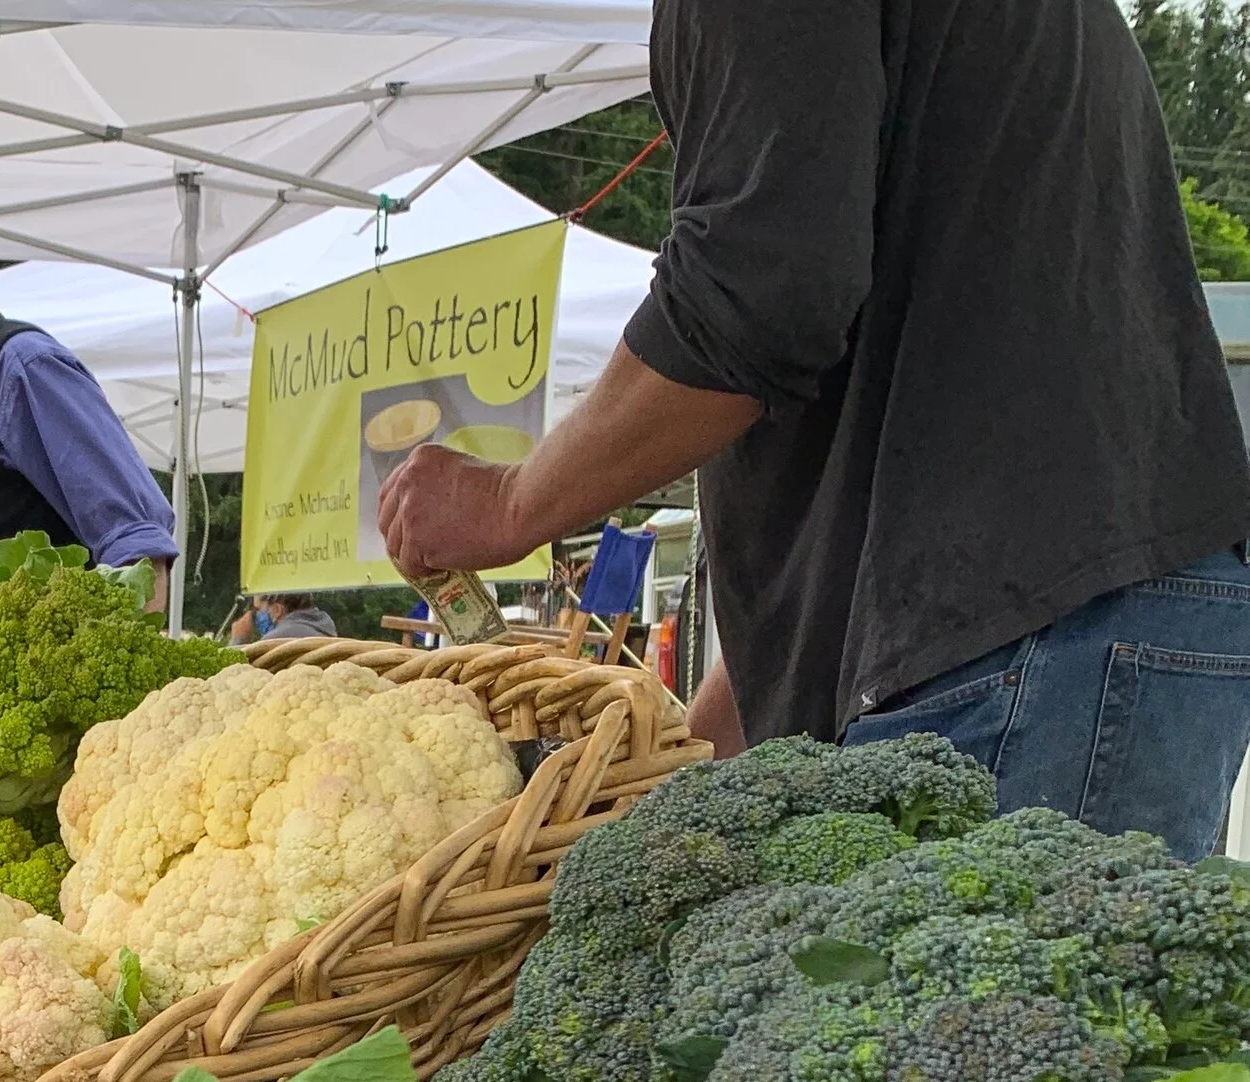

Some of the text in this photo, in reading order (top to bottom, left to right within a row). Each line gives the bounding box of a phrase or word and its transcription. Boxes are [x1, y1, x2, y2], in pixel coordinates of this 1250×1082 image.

[268, 287, 539, 403] McMud Pottery
[333, 537, 350, 559] WA
